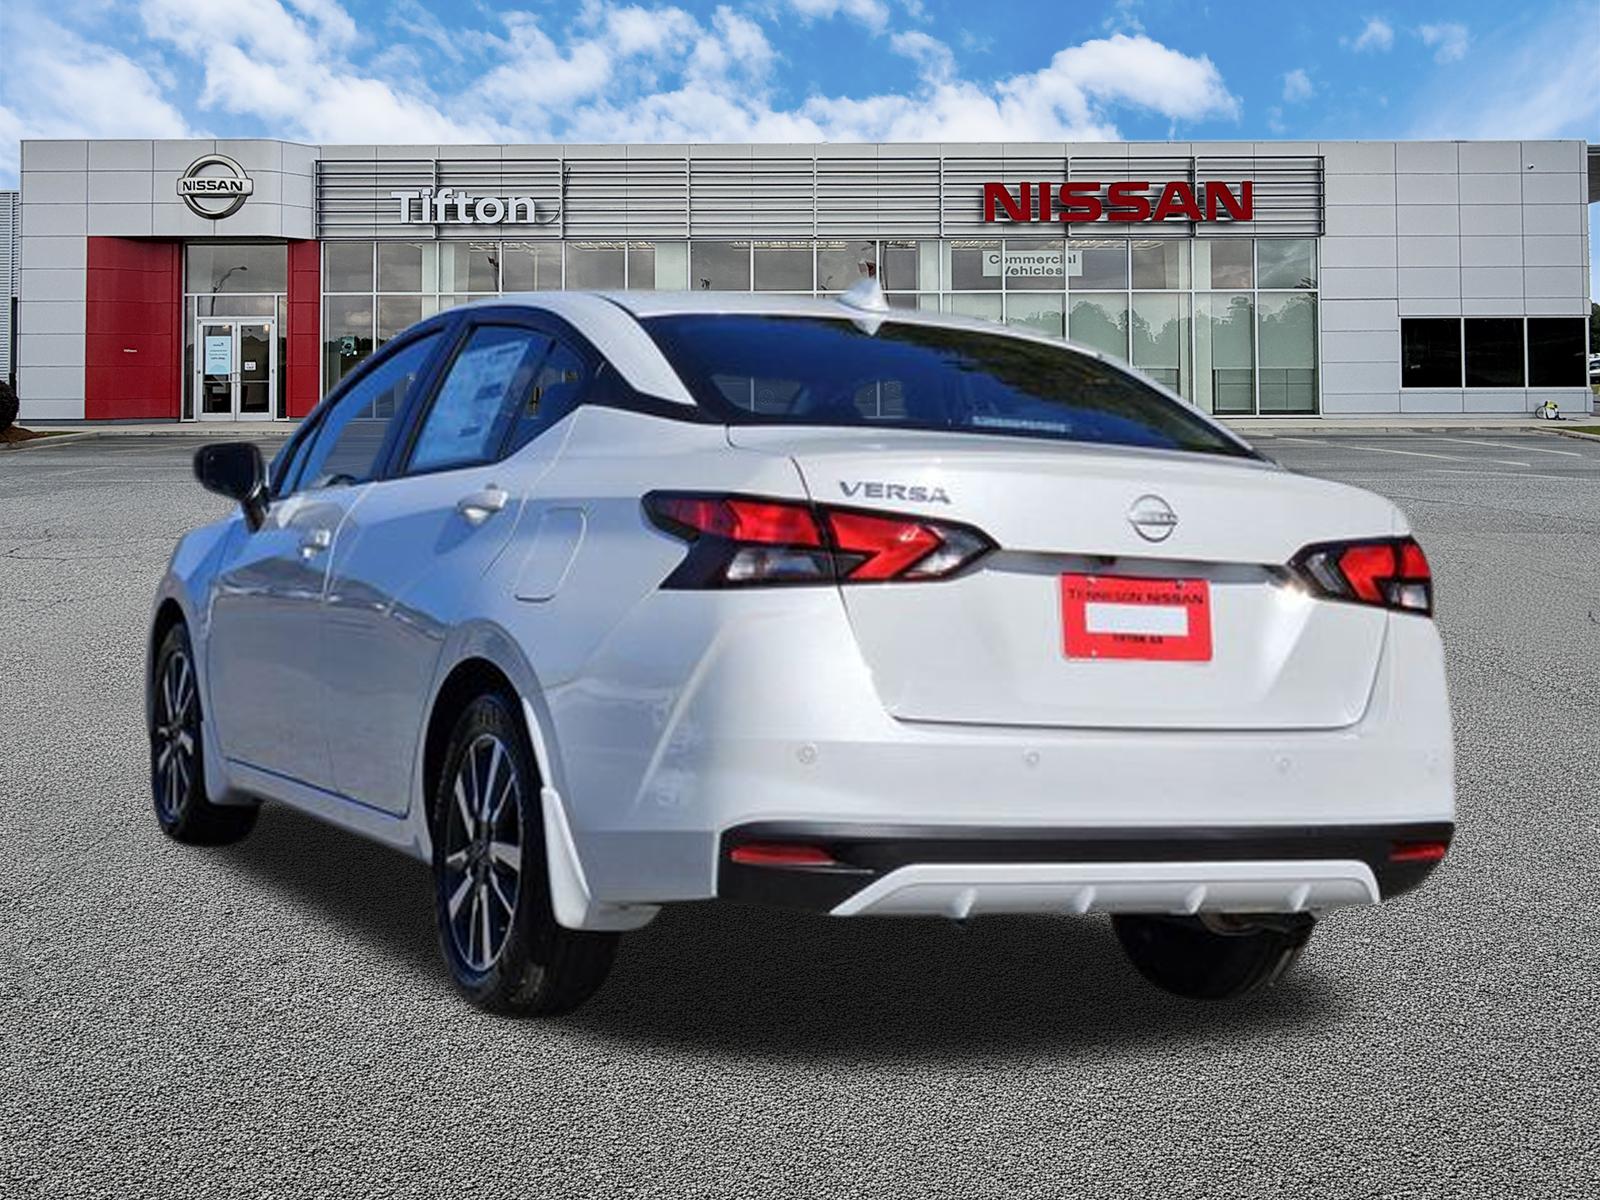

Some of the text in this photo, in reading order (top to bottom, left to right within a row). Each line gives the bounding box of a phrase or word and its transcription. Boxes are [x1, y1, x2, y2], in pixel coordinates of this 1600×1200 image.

[182, 180, 243, 192] NISSAN
[391, 188, 536, 224] Tifton
[983, 181, 1254, 221] NISSAN
[839, 481, 952, 504] VERSA
